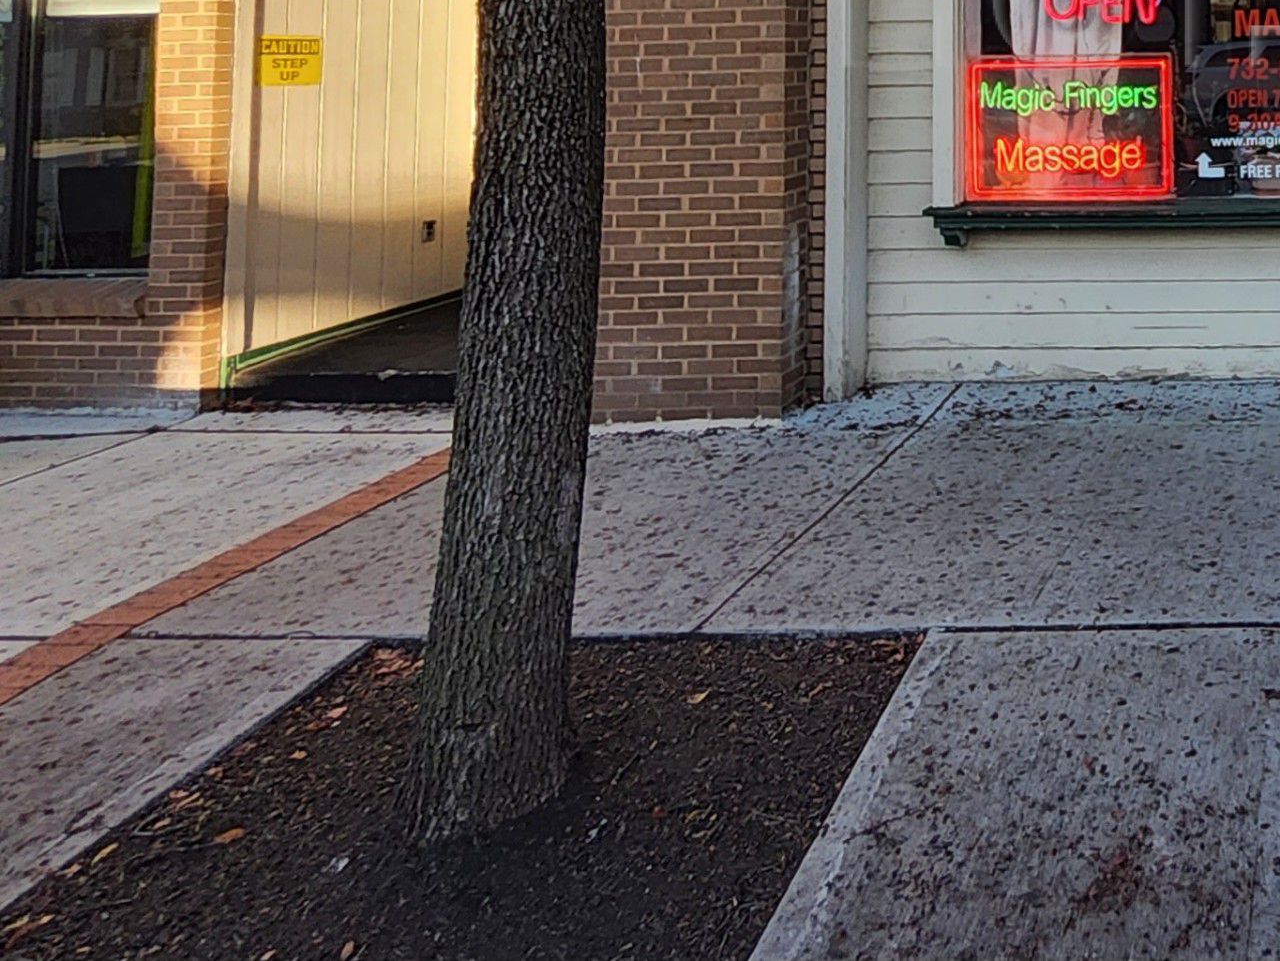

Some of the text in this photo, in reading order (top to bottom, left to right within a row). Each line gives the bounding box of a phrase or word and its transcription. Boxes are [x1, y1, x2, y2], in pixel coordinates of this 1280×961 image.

[262, 40, 320, 54] CAUTION
[271, 58, 308, 69] STEP
[280, 71, 300, 81] UP
[980, 81, 1158, 117] Magic Fingers
[1227, 89, 1268, 109] OPEN
[996, 138, 1143, 178] Massage
[1240, 164, 1274, 178] FREE
